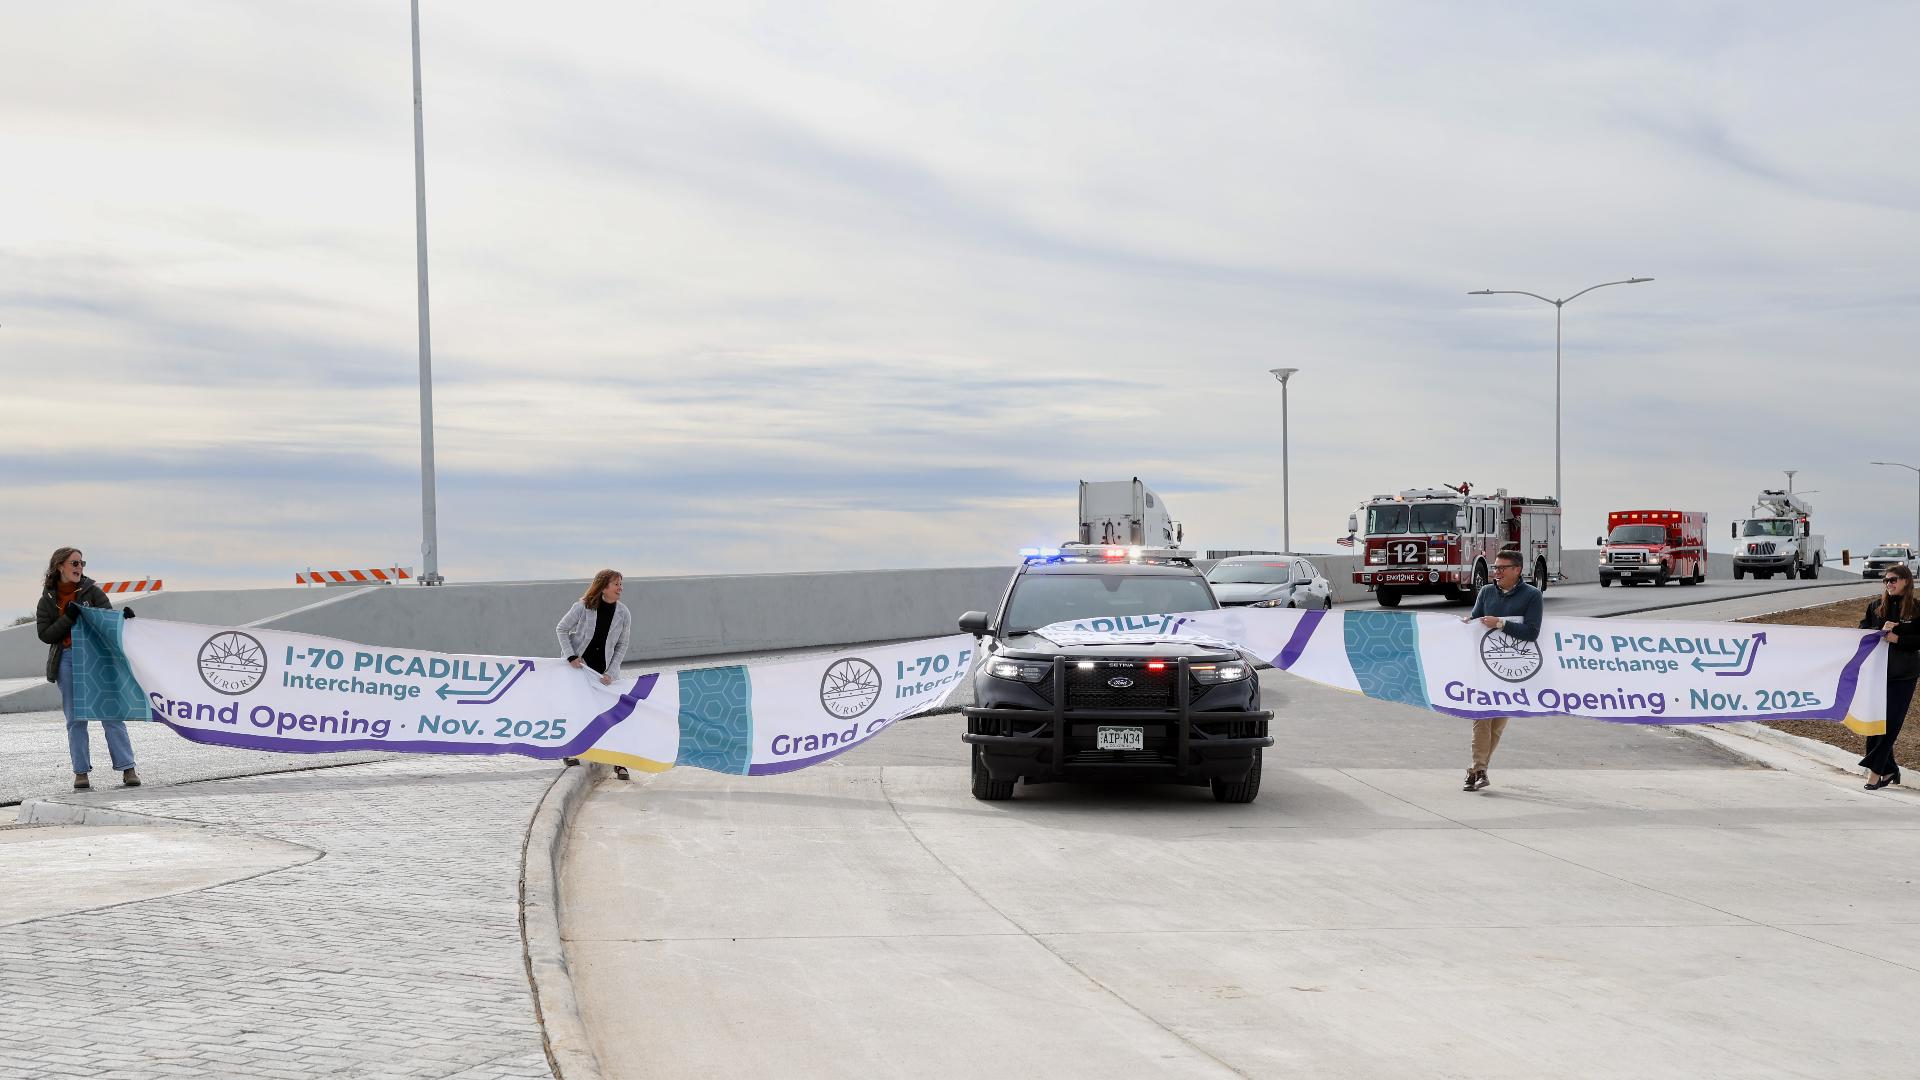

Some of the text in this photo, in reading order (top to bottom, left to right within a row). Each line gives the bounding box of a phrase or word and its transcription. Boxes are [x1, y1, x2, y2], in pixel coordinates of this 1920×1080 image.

[1394, 543, 1418, 562] 12
[1554, 632, 1750, 656] I-70 PICADILLY
[285, 646, 516, 682] I-70 PICADILLY
[897, 654, 950, 680] I-70
[1490, 660, 1537, 677] AURORA
[1559, 655, 1679, 674] Interchange
[206, 671, 256, 690] AURORA
[283, 671, 421, 700] Interchange
[829, 696, 872, 715] AURORA
[1445, 681, 1821, 714] Grand Opening Nov. 2025
[150, 692, 567, 740] Grand Opening Nov. 2025
[771, 723, 859, 756] Grand
